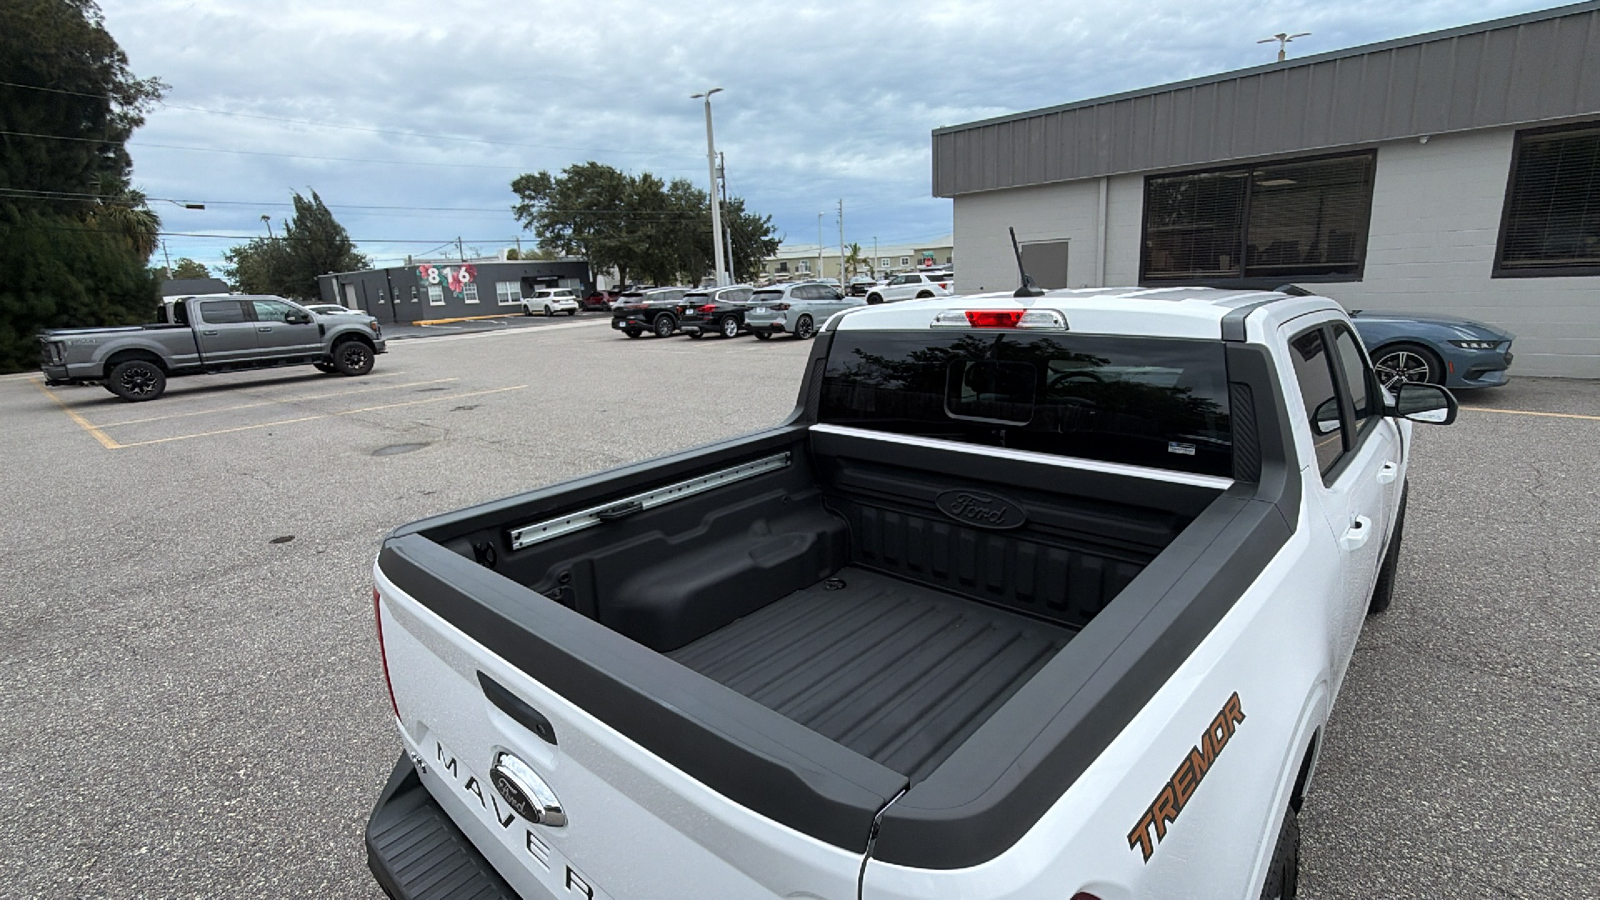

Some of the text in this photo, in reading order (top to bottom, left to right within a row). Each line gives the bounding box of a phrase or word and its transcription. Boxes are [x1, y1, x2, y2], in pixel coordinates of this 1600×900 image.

[427, 266, 470, 284] 816
[951, 492, 1007, 523] Ford
[1127, 691, 1246, 865] TREMOR
[498, 777, 527, 815] Ford
